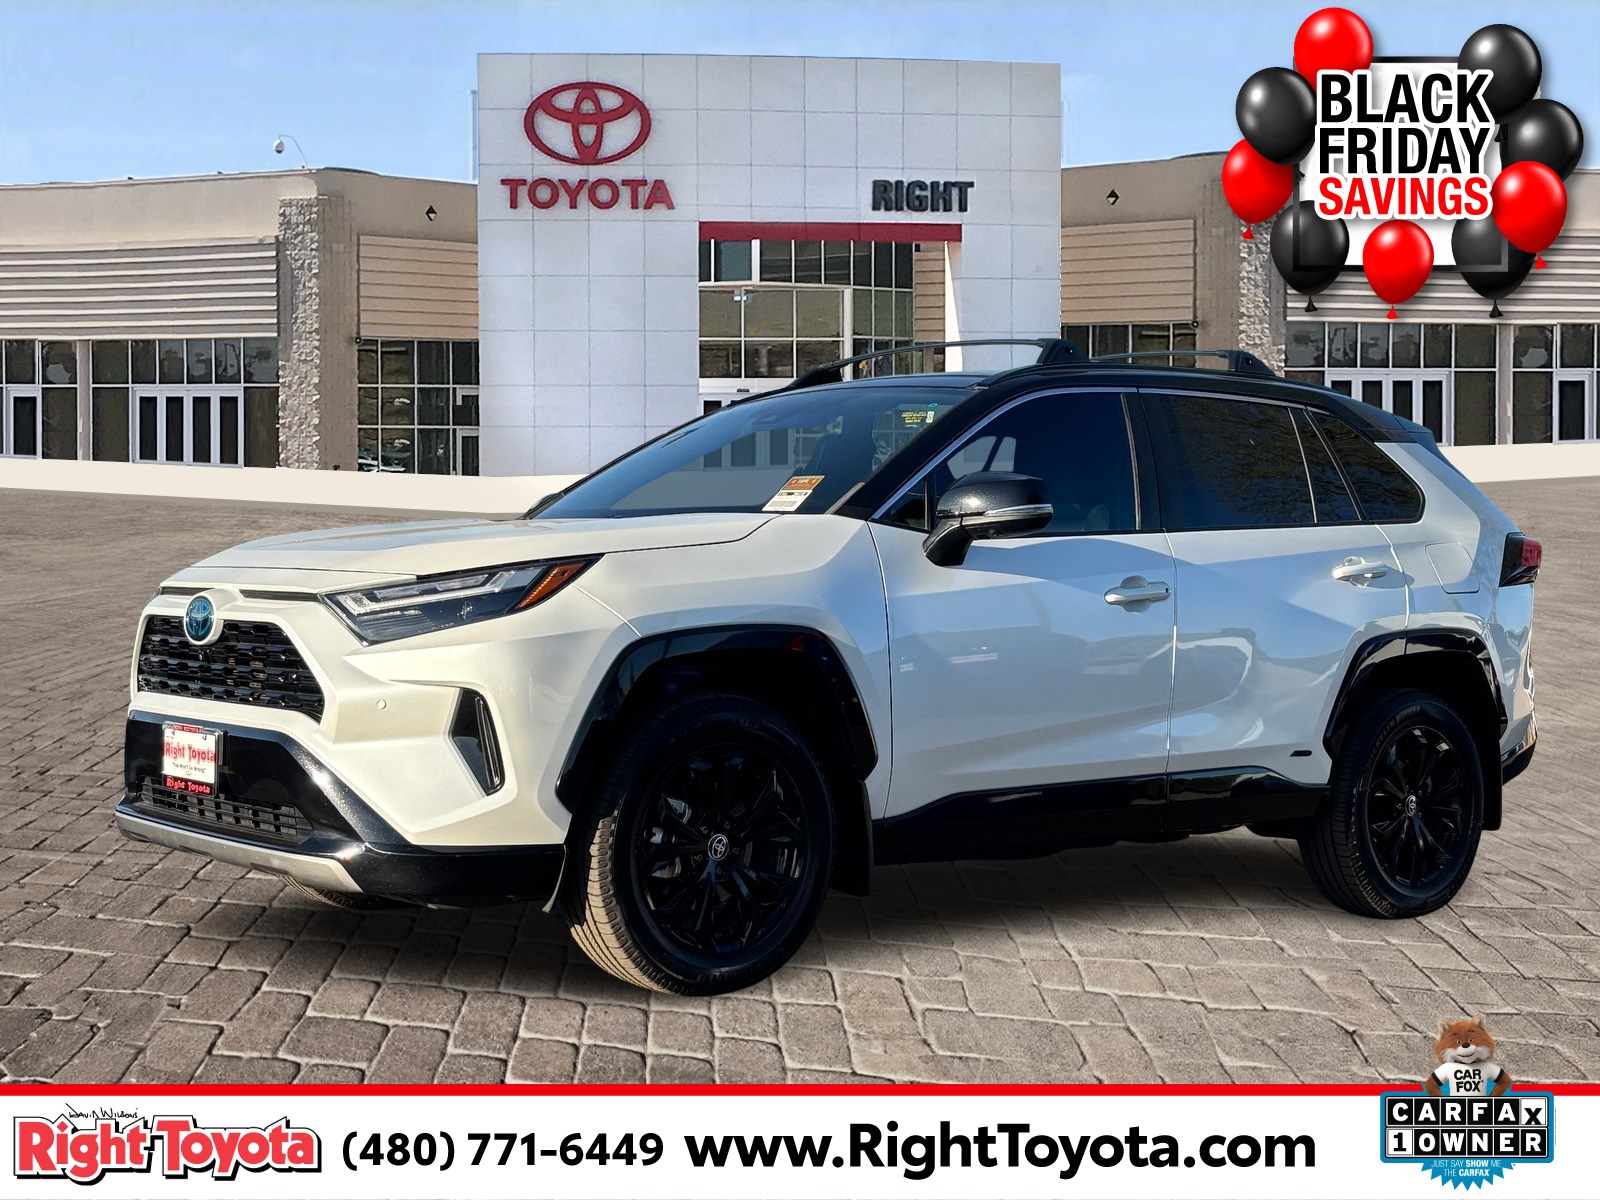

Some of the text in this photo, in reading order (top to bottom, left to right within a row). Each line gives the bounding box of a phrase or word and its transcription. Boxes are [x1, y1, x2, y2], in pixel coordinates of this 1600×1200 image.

[501, 178, 675, 210] TOYOTA
[871, 179, 976, 213] RIGHT
[165, 741, 216, 764] Right Toyota
